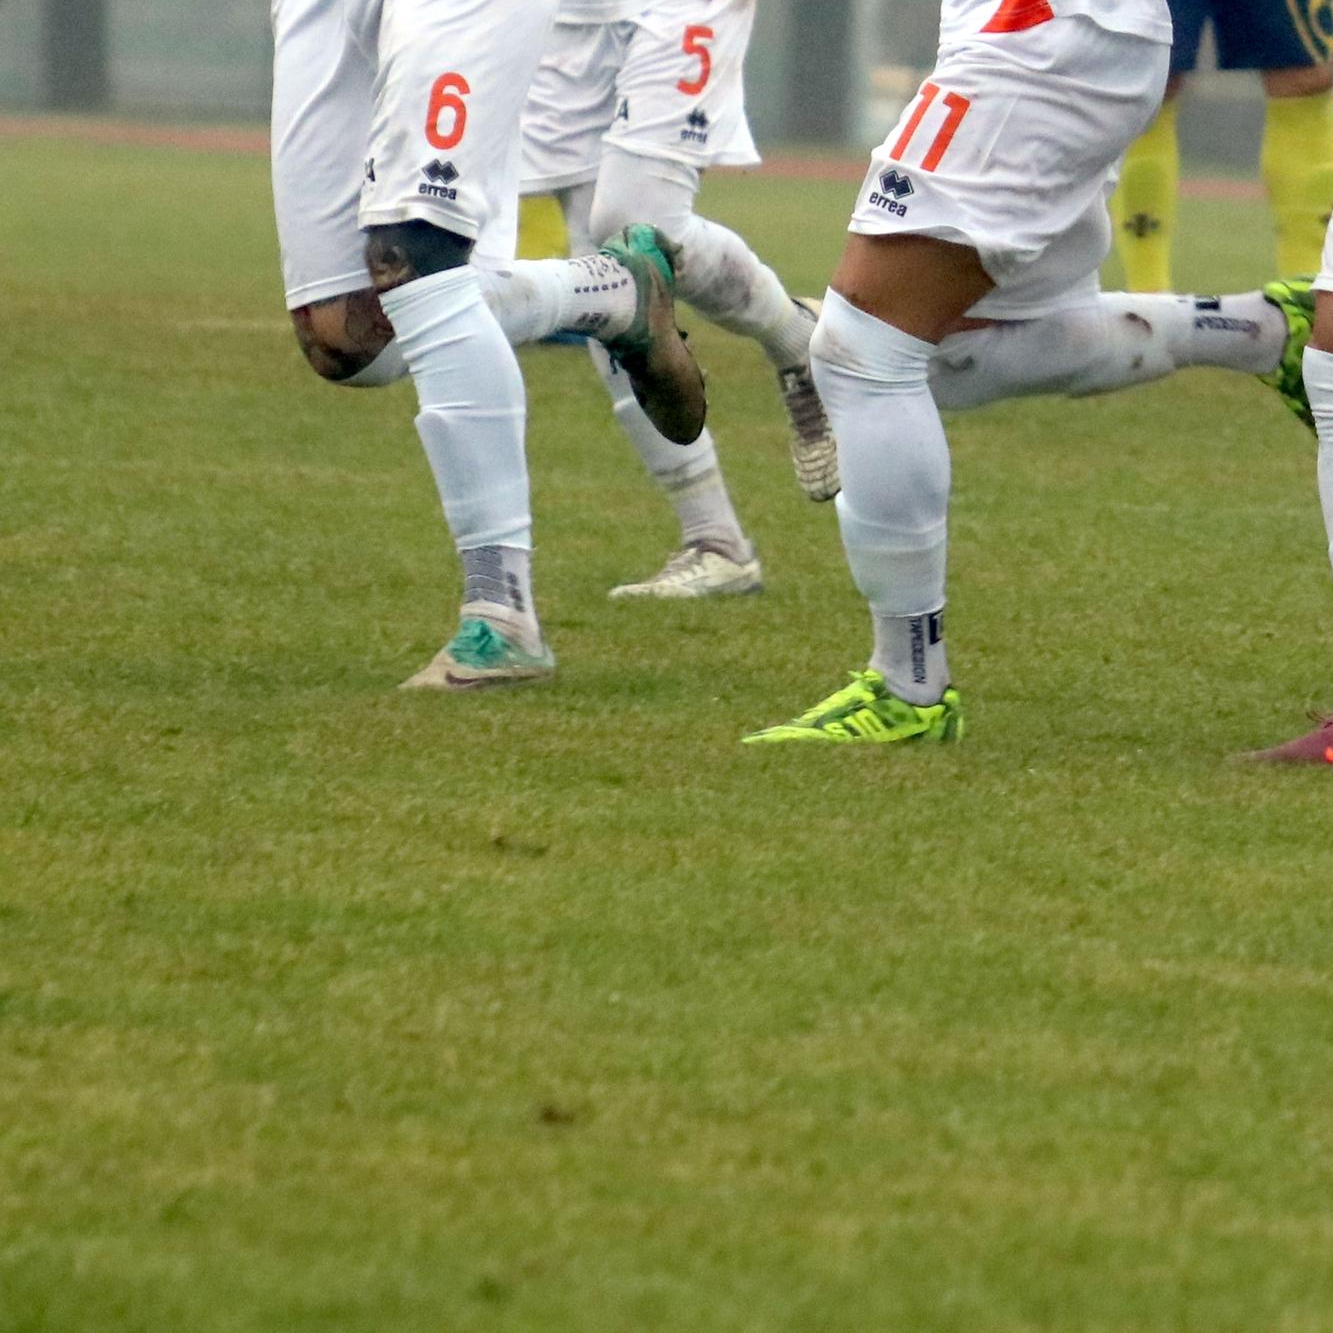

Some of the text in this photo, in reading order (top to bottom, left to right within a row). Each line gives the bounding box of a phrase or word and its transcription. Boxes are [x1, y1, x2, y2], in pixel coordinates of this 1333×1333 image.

[676, 24, 714, 96] 5
[425, 72, 471, 150] 6
[889, 81, 971, 173] 11
[418, 183, 457, 201] errea
[868, 191, 908, 218] errea
